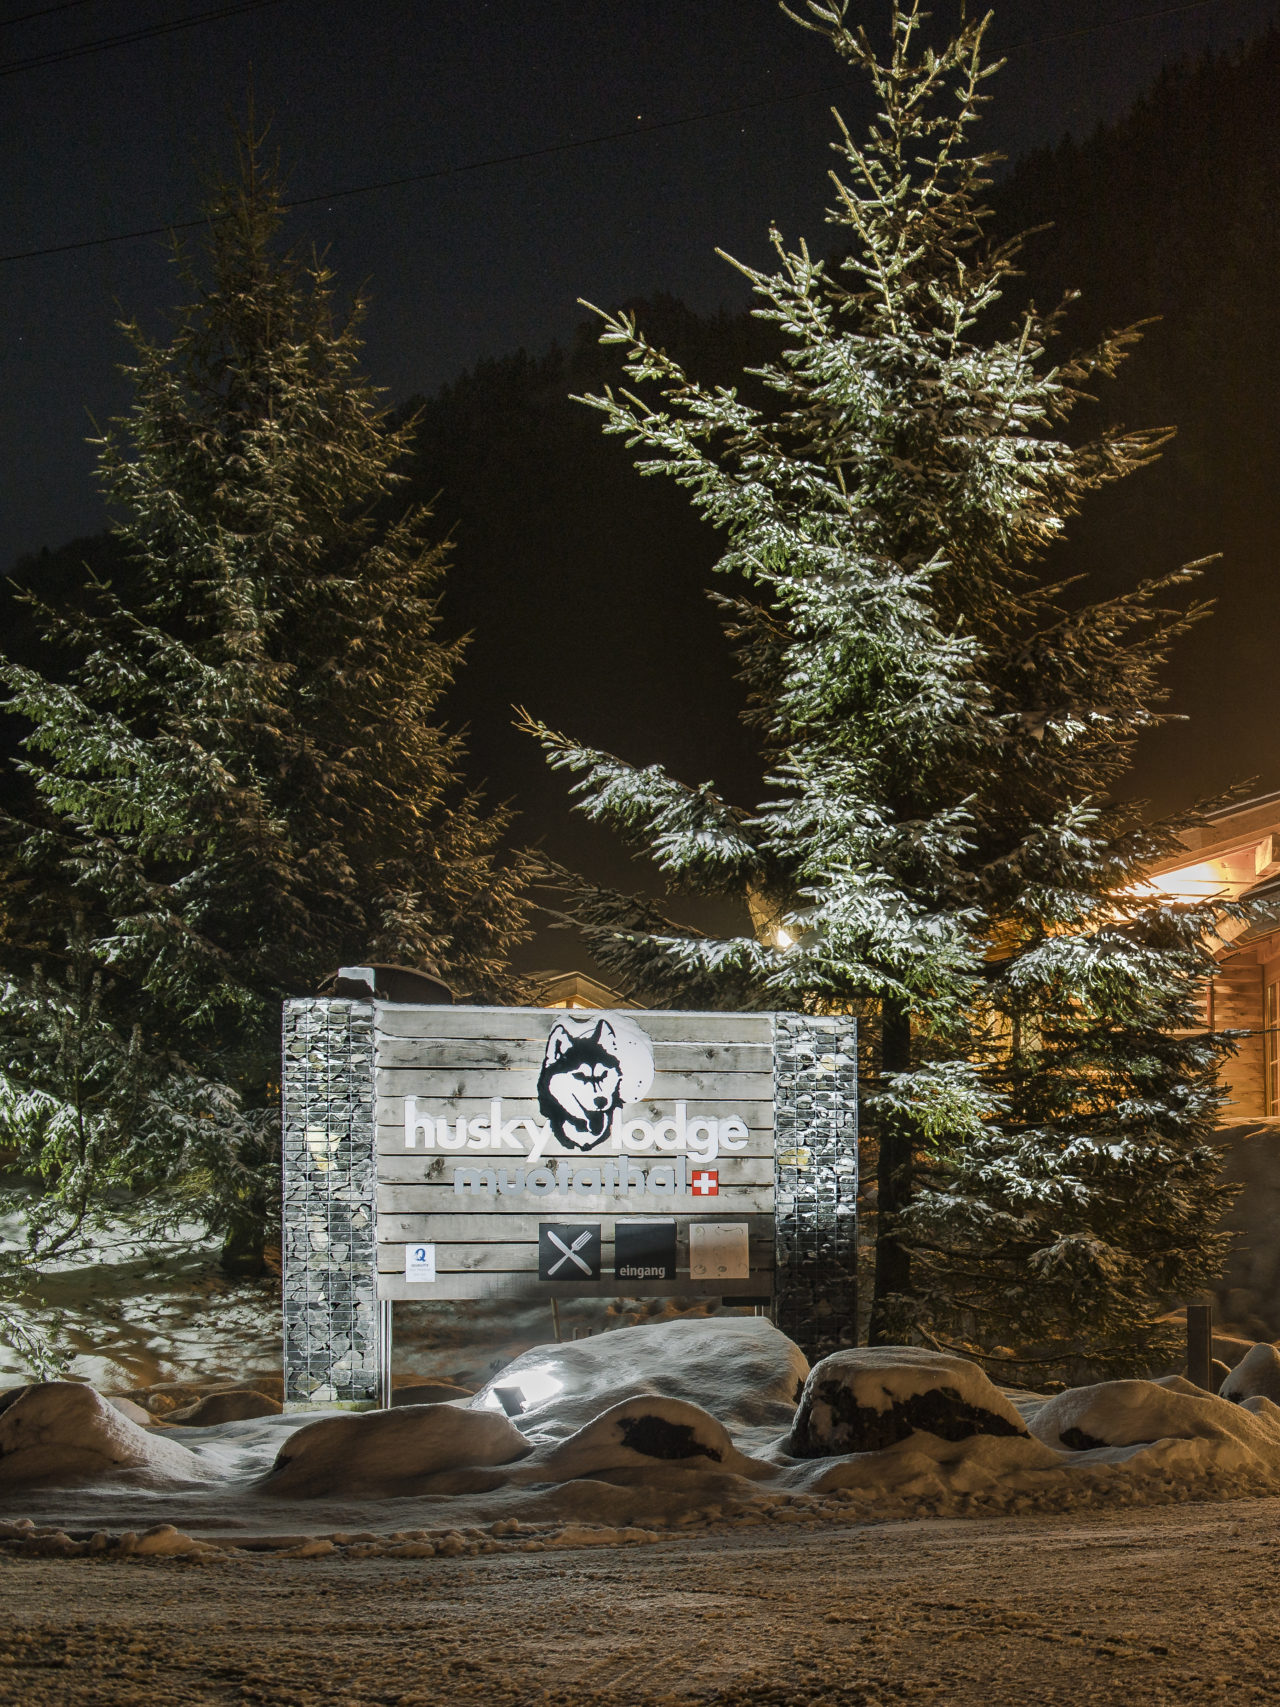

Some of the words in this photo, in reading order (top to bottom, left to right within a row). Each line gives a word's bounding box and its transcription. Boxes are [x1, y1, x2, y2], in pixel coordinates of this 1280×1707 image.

[404, 1096, 552, 1163] husky
[611, 1099, 749, 1163] lodge
[453, 1155, 687, 1197] muotathal
[415, 1248, 426, 1262] Q
[619, 1265, 666, 1279] eingang
